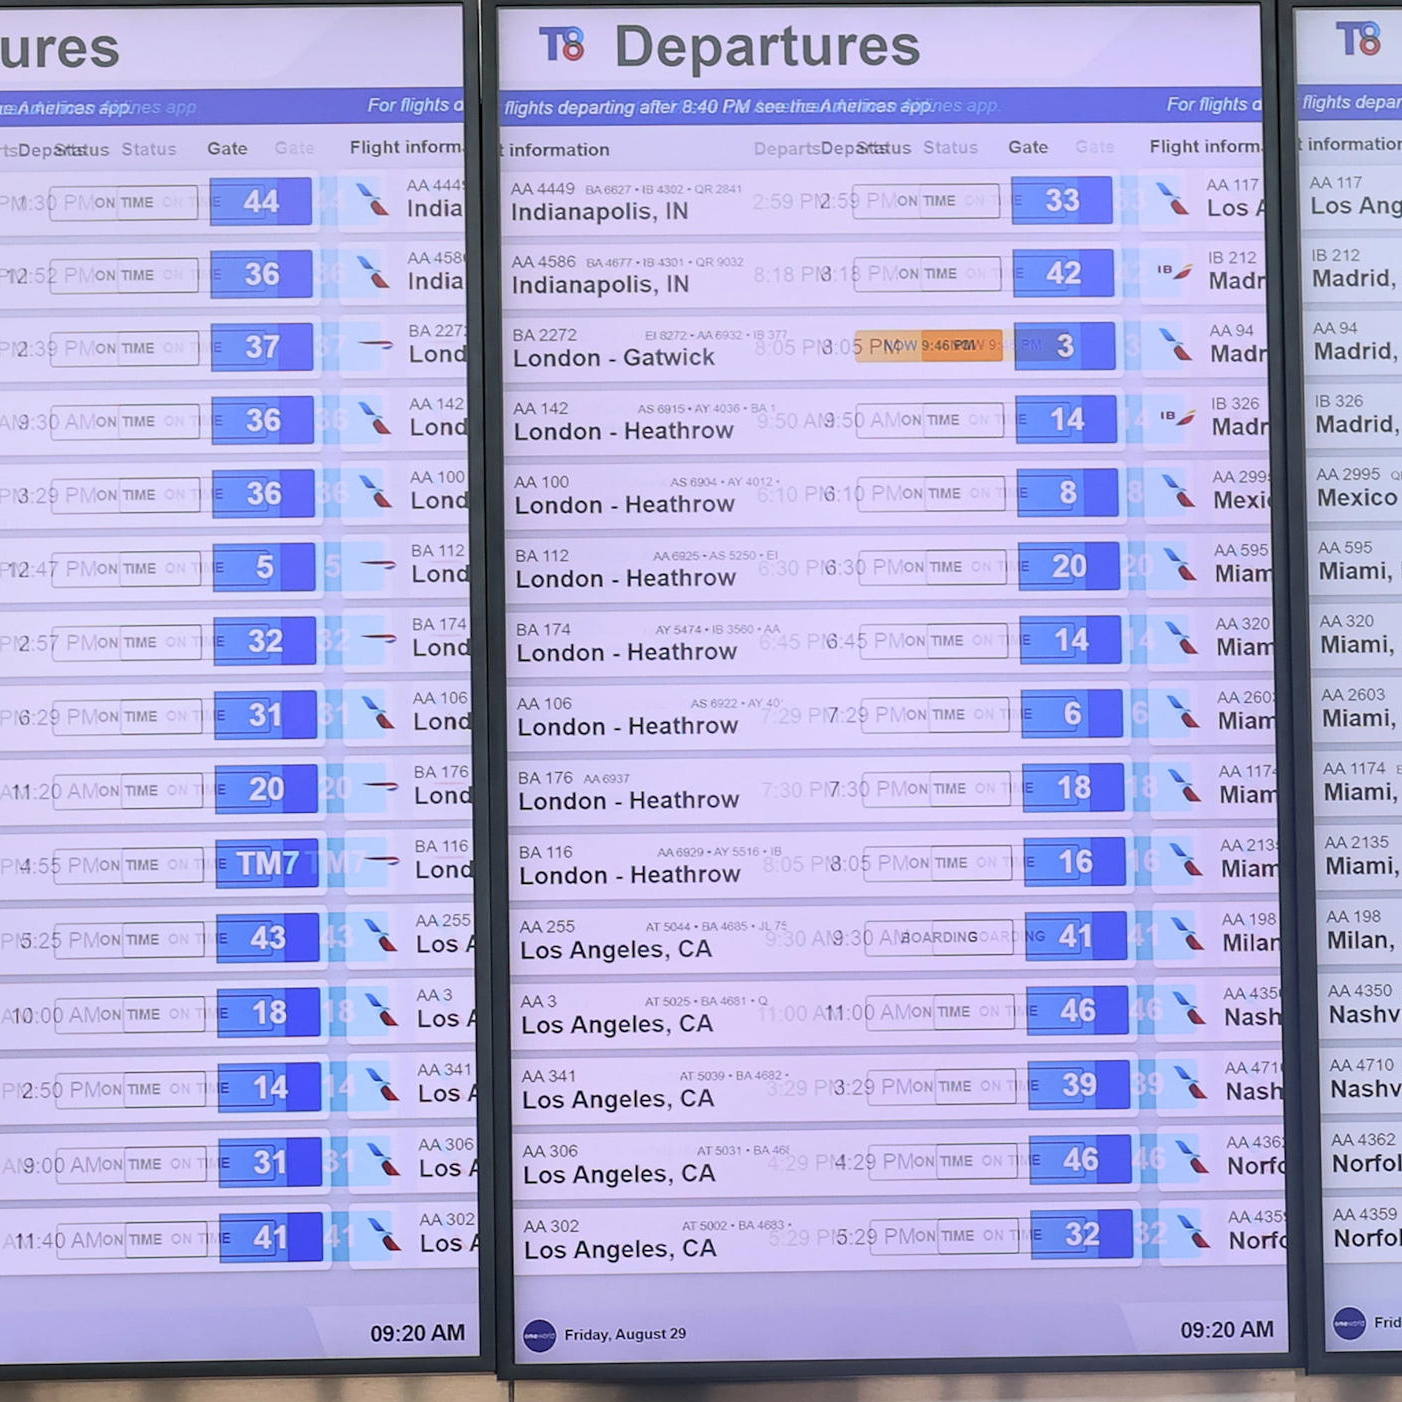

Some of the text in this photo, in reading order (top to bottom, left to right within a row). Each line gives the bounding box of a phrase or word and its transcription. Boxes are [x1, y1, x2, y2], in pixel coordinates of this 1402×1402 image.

[538, 25, 585, 62] T8
[1335, 20, 1382, 57] T8
[616, 24, 920, 79] Departures
[207, 141, 248, 156] Gate
[510, 182, 575, 196] AA 4449
[1047, 188, 1080, 211] 33
[244, 189, 279, 213] 44
[512, 201, 688, 225] Indianapolis, IN
[1311, 248, 1360, 262] IB 212
[1312, 268, 1396, 290] Madrid,
[1317, 487, 1398, 507] Mexico
[236, 851, 300, 877] TM7
[523, 1219, 579, 1234] AA 302
[1066, 1222, 1100, 1246] 32
[525, 1238, 717, 1264] Los Angeles, CA
[370, 1323, 465, 1343] 09:20 AM
[565, 1327, 687, 1344] Friday, August 29
[1181, 1320, 1274, 1339] 09:20 AM
